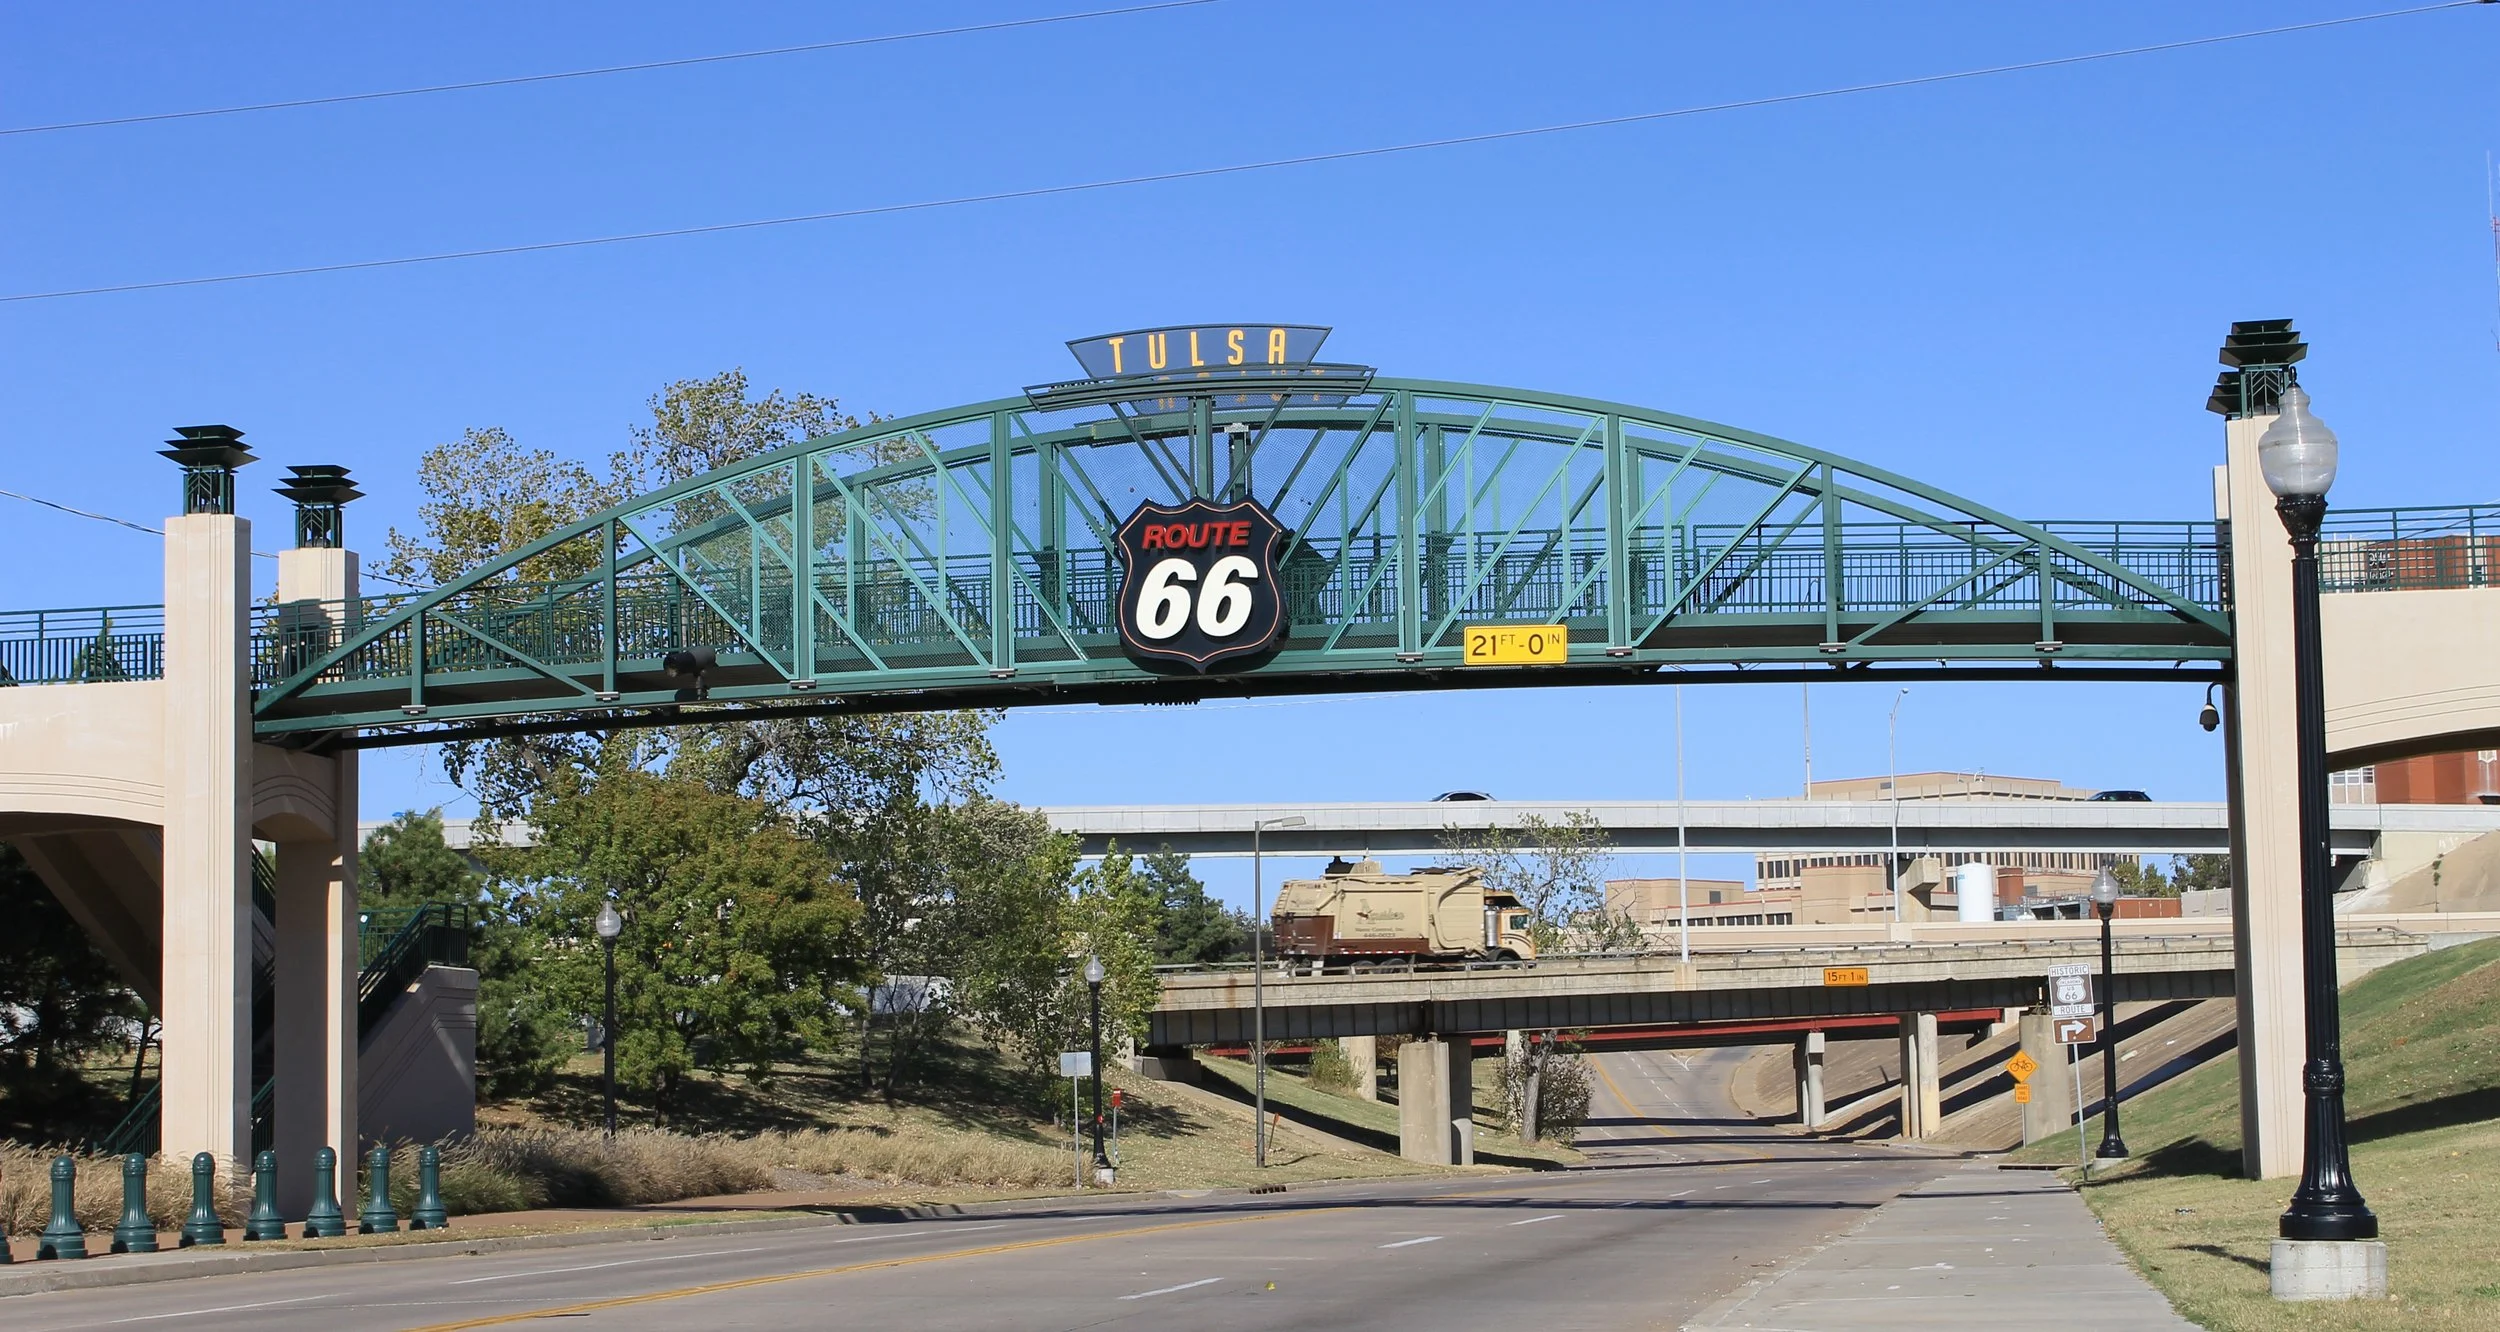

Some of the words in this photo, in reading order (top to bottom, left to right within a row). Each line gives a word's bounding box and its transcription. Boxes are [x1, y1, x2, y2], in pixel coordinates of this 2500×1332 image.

[1108, 328, 1286, 374] TULSA
[1141, 520, 1252, 550] ROUTE
[1136, 555, 1258, 640] 66
[2051, 965, 2088, 976] HISTORIC
[2065, 991, 2078, 1001] 66
[2060, 1005, 2086, 1014] ROUTE
